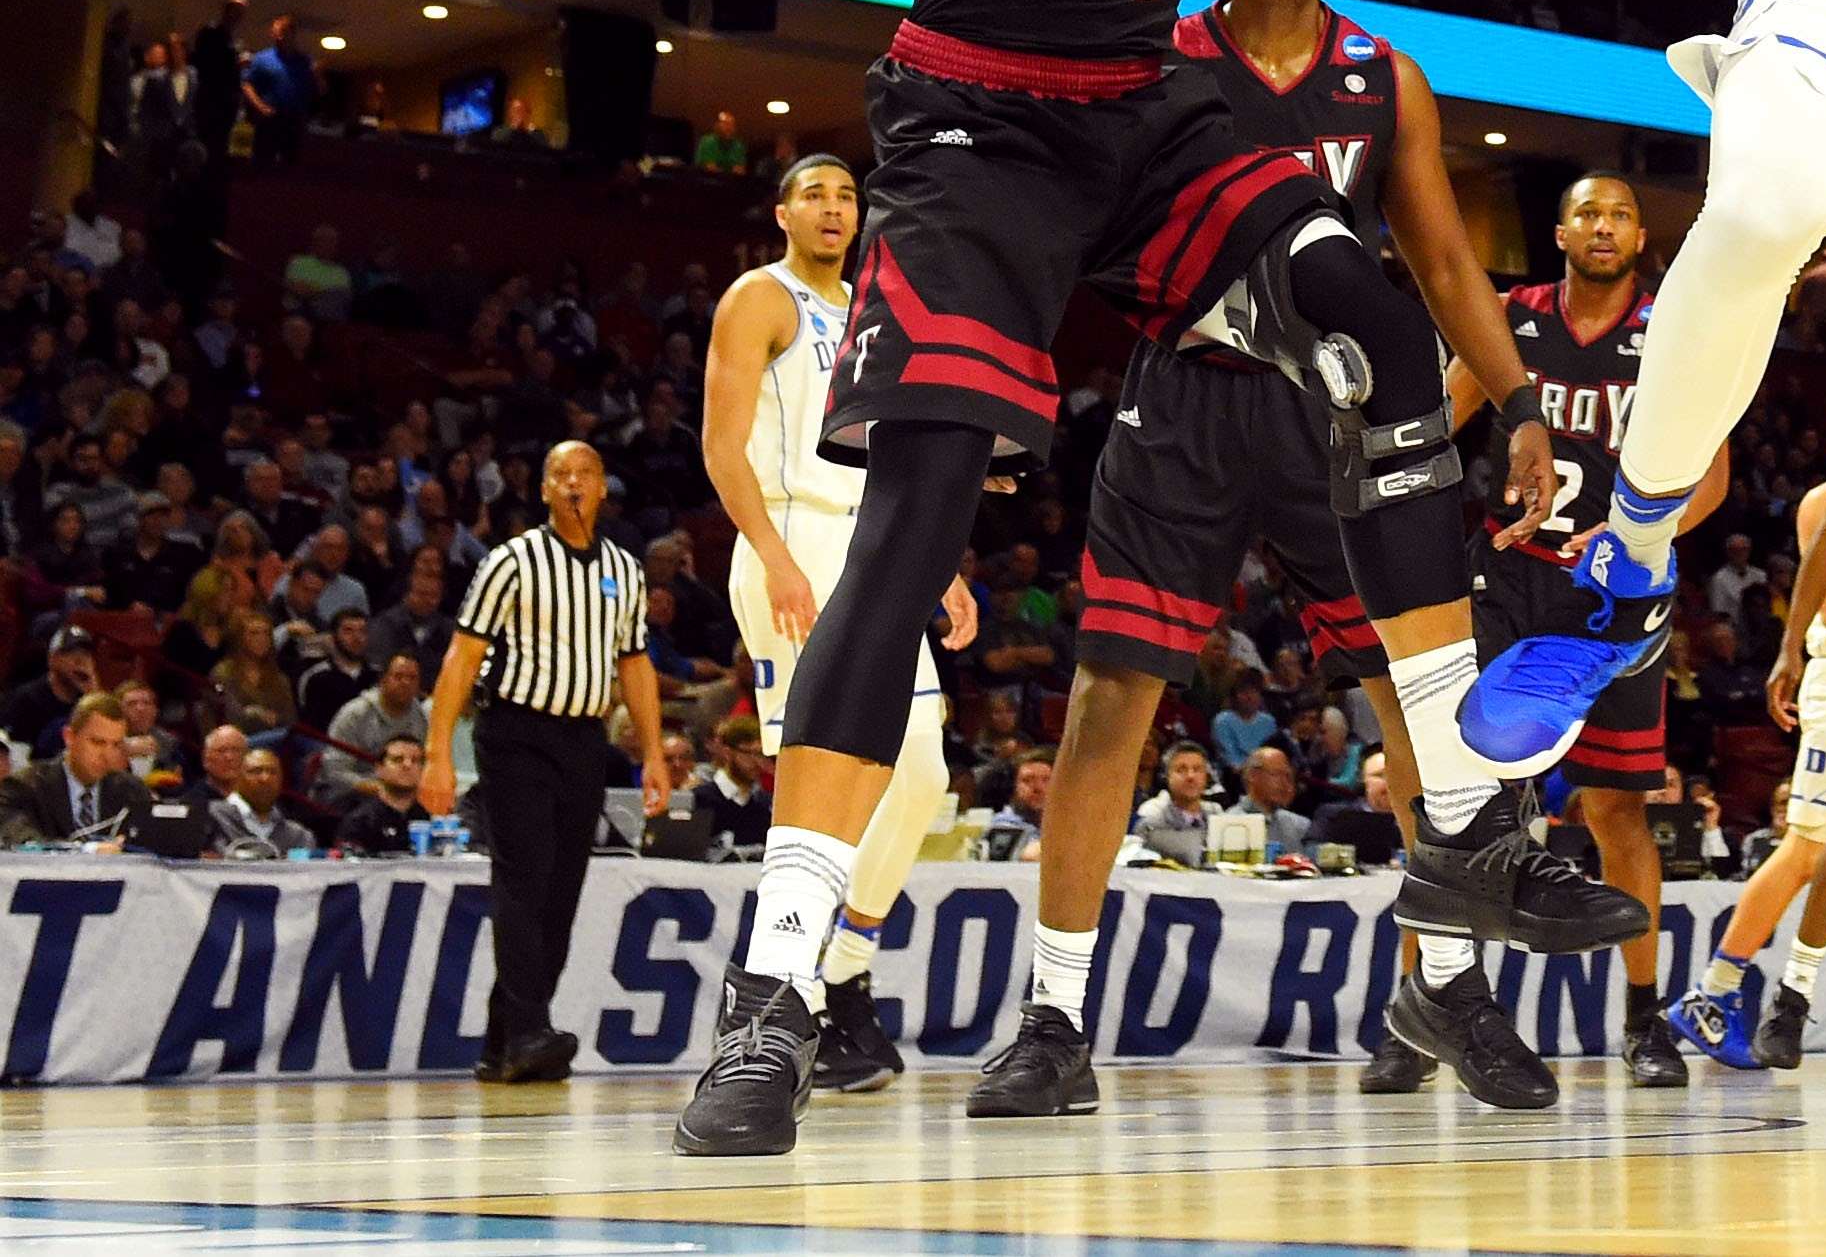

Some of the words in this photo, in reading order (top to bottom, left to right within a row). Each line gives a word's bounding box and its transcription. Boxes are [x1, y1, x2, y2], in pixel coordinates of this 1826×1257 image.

[1527, 372, 1638, 451] ROY
[1538, 459, 1584, 533] 2
[3, 879, 125, 1076] T
